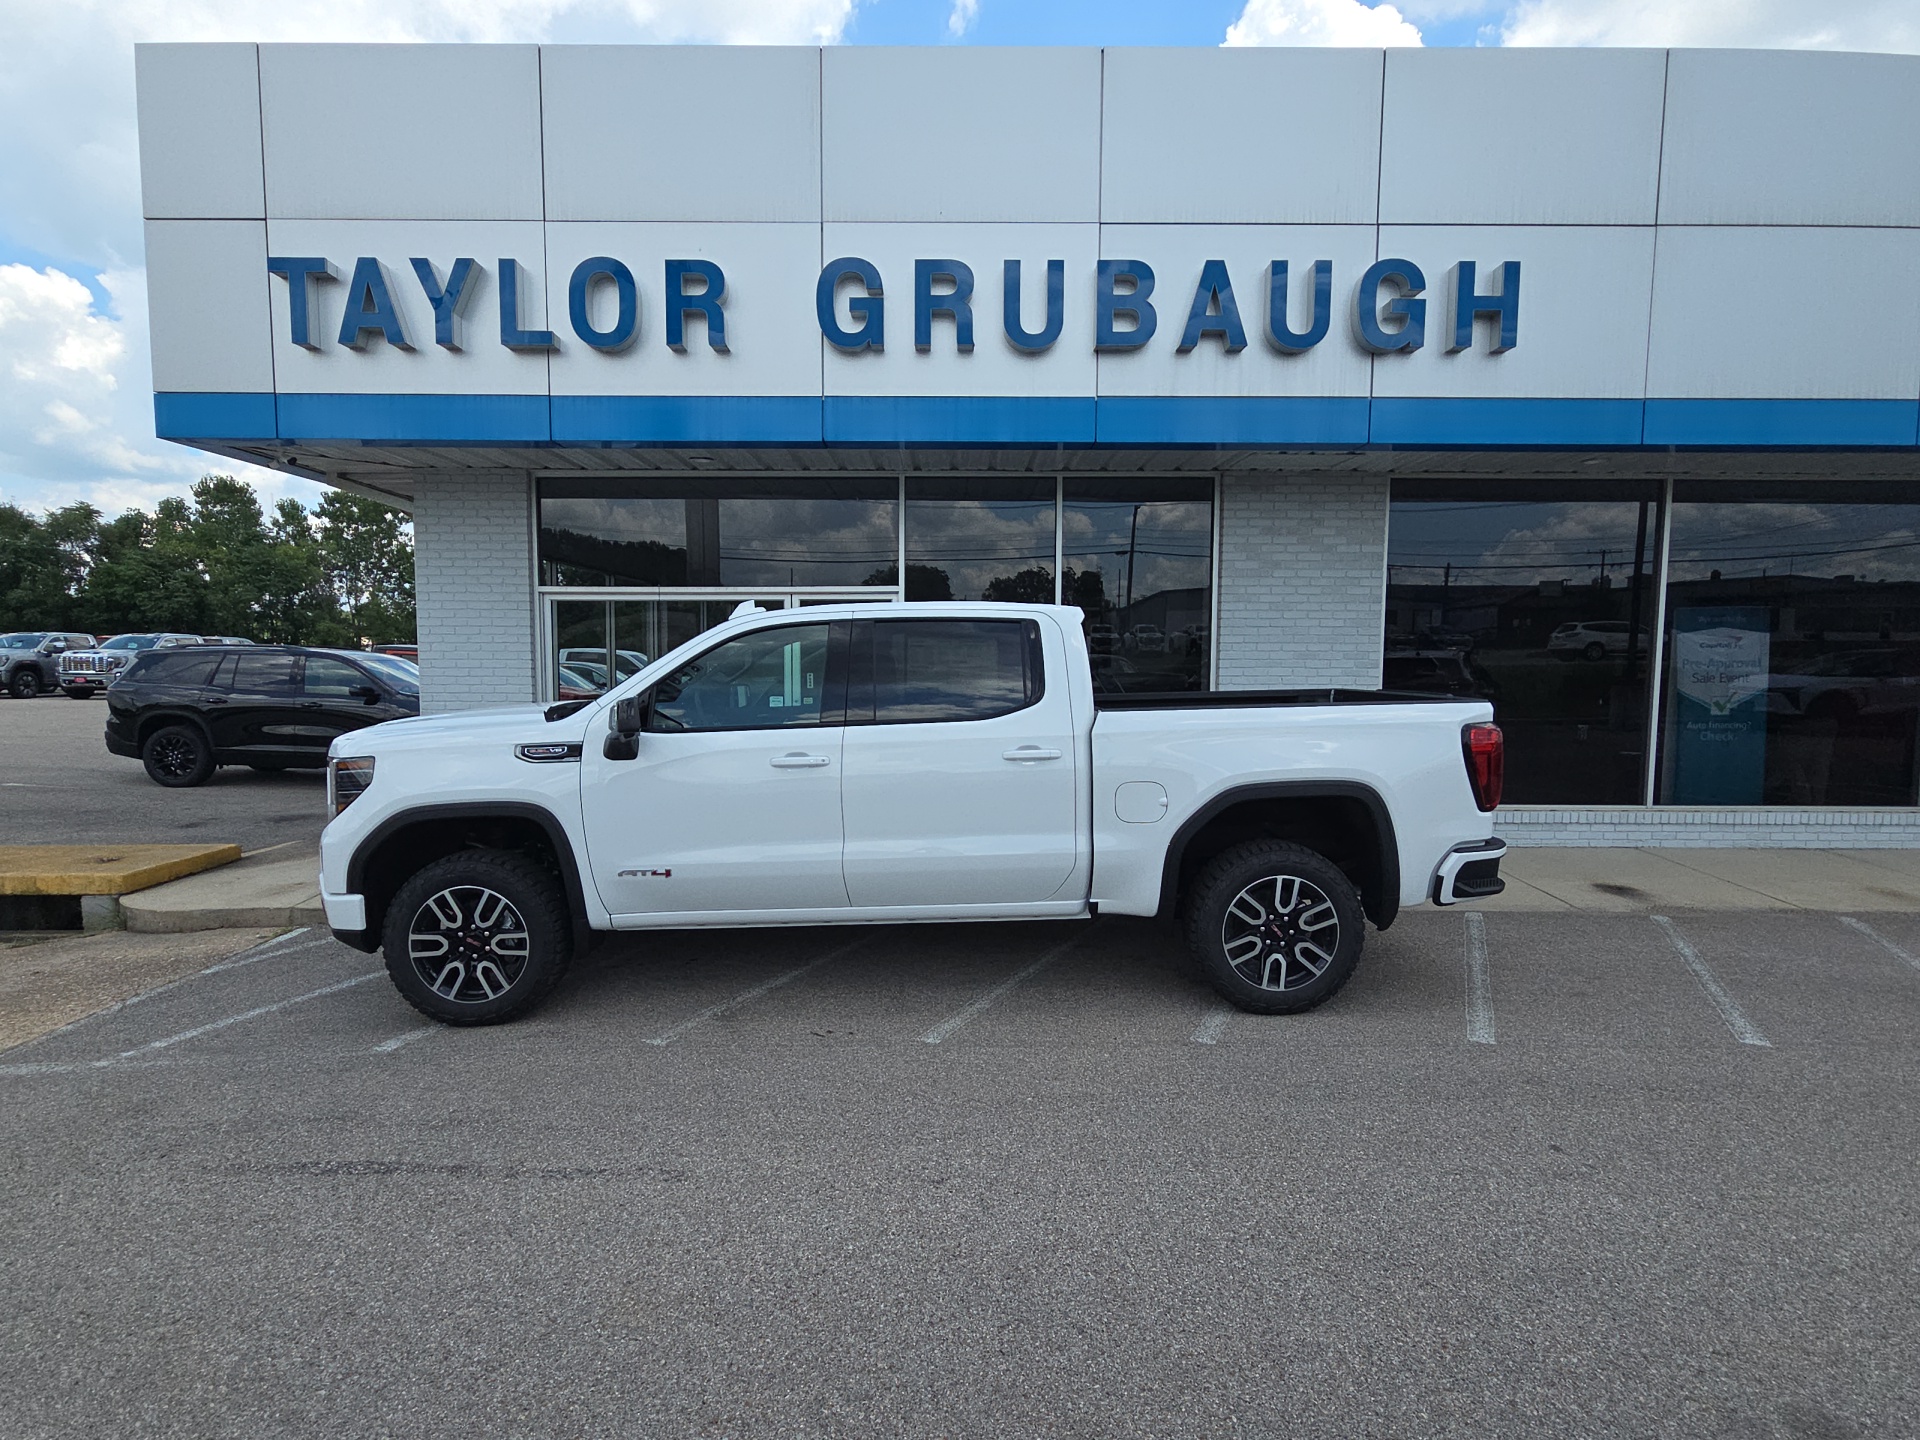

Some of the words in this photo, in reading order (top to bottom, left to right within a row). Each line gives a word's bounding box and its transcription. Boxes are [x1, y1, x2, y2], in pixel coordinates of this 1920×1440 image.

[267, 256, 730, 352] TAYLOR
[815, 256, 1521, 354] GRUBAUGH
[1682, 658, 1762, 671] Pre-Approval
[1692, 673, 1715, 683] Sale
[1719, 673, 1749, 684] Event
[1686, 721, 1707, 729] Auto
[1708, 721, 1752, 731] financing?
[617, 869, 672, 878] AT4
